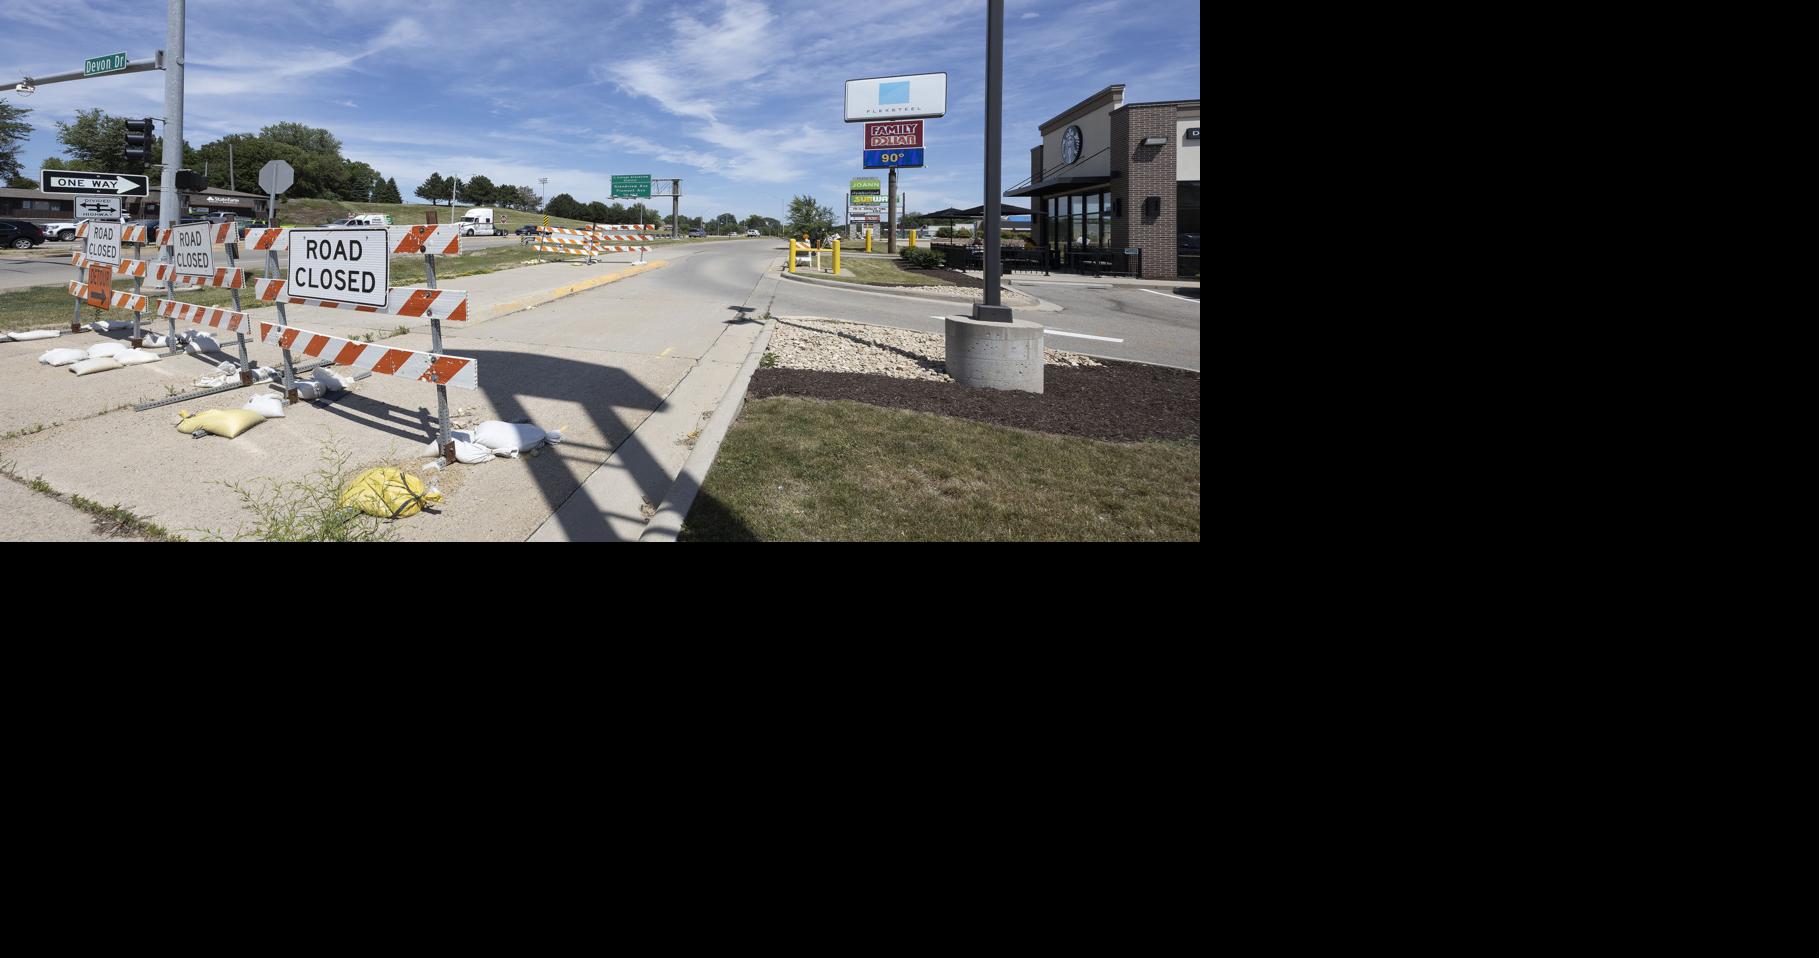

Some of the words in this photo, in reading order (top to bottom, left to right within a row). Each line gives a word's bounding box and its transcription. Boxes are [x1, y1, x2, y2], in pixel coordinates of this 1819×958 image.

[87, 59, 110, 73] Devon
[115, 56, 124, 68] Dr
[871, 124, 917, 136] FAMILY
[881, 153, 904, 162] 90°
[58, 178, 85, 187] ONE
[92, 180, 117, 188] WAY
[853, 195, 889, 203] SUBWA
[94, 227, 113, 240] ROAD
[180, 231, 202, 246] ROAD
[89, 243, 116, 258] CLOSED
[307, 239, 362, 261] ROAD
[177, 252, 208, 268] CLOSED
[89, 266, 110, 287] DETOUR
[295, 267, 375, 293] CLOSED
